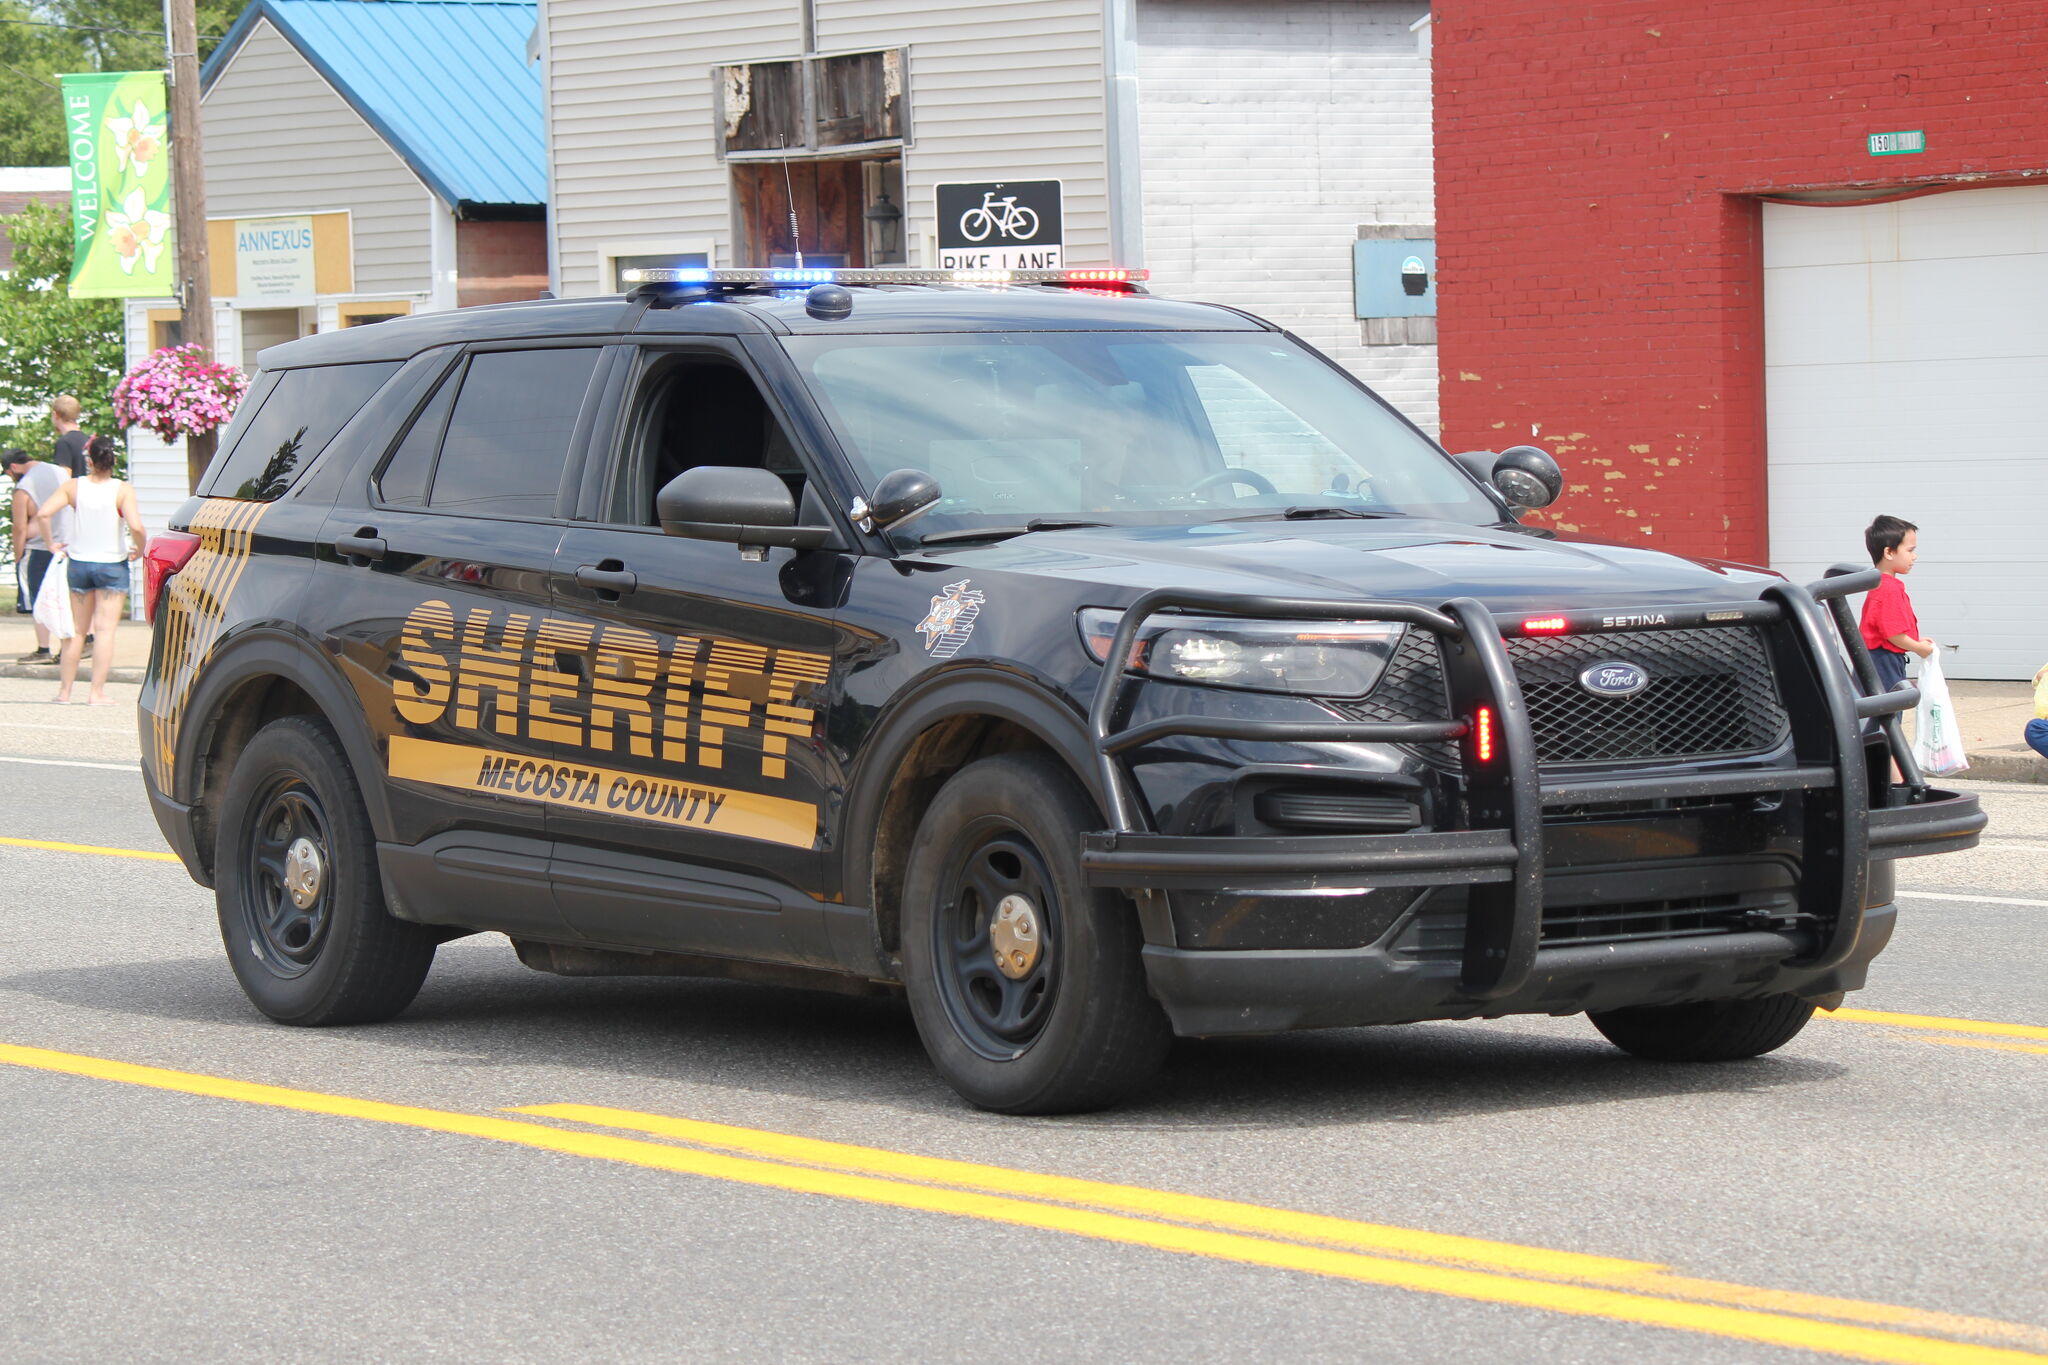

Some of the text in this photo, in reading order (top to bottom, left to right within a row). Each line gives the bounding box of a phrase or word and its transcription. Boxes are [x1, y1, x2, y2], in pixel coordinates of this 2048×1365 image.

[1873, 136, 1889, 151] 150
[70, 95, 98, 242] WELCOME
[238, 229, 312, 252] ANNEXUS
[1602, 614, 1666, 628] SETINA
[393, 599, 832, 780] SHERIFF
[1599, 669, 1639, 687] Ford
[476, 755, 727, 825] MECOSTA COUNTY
